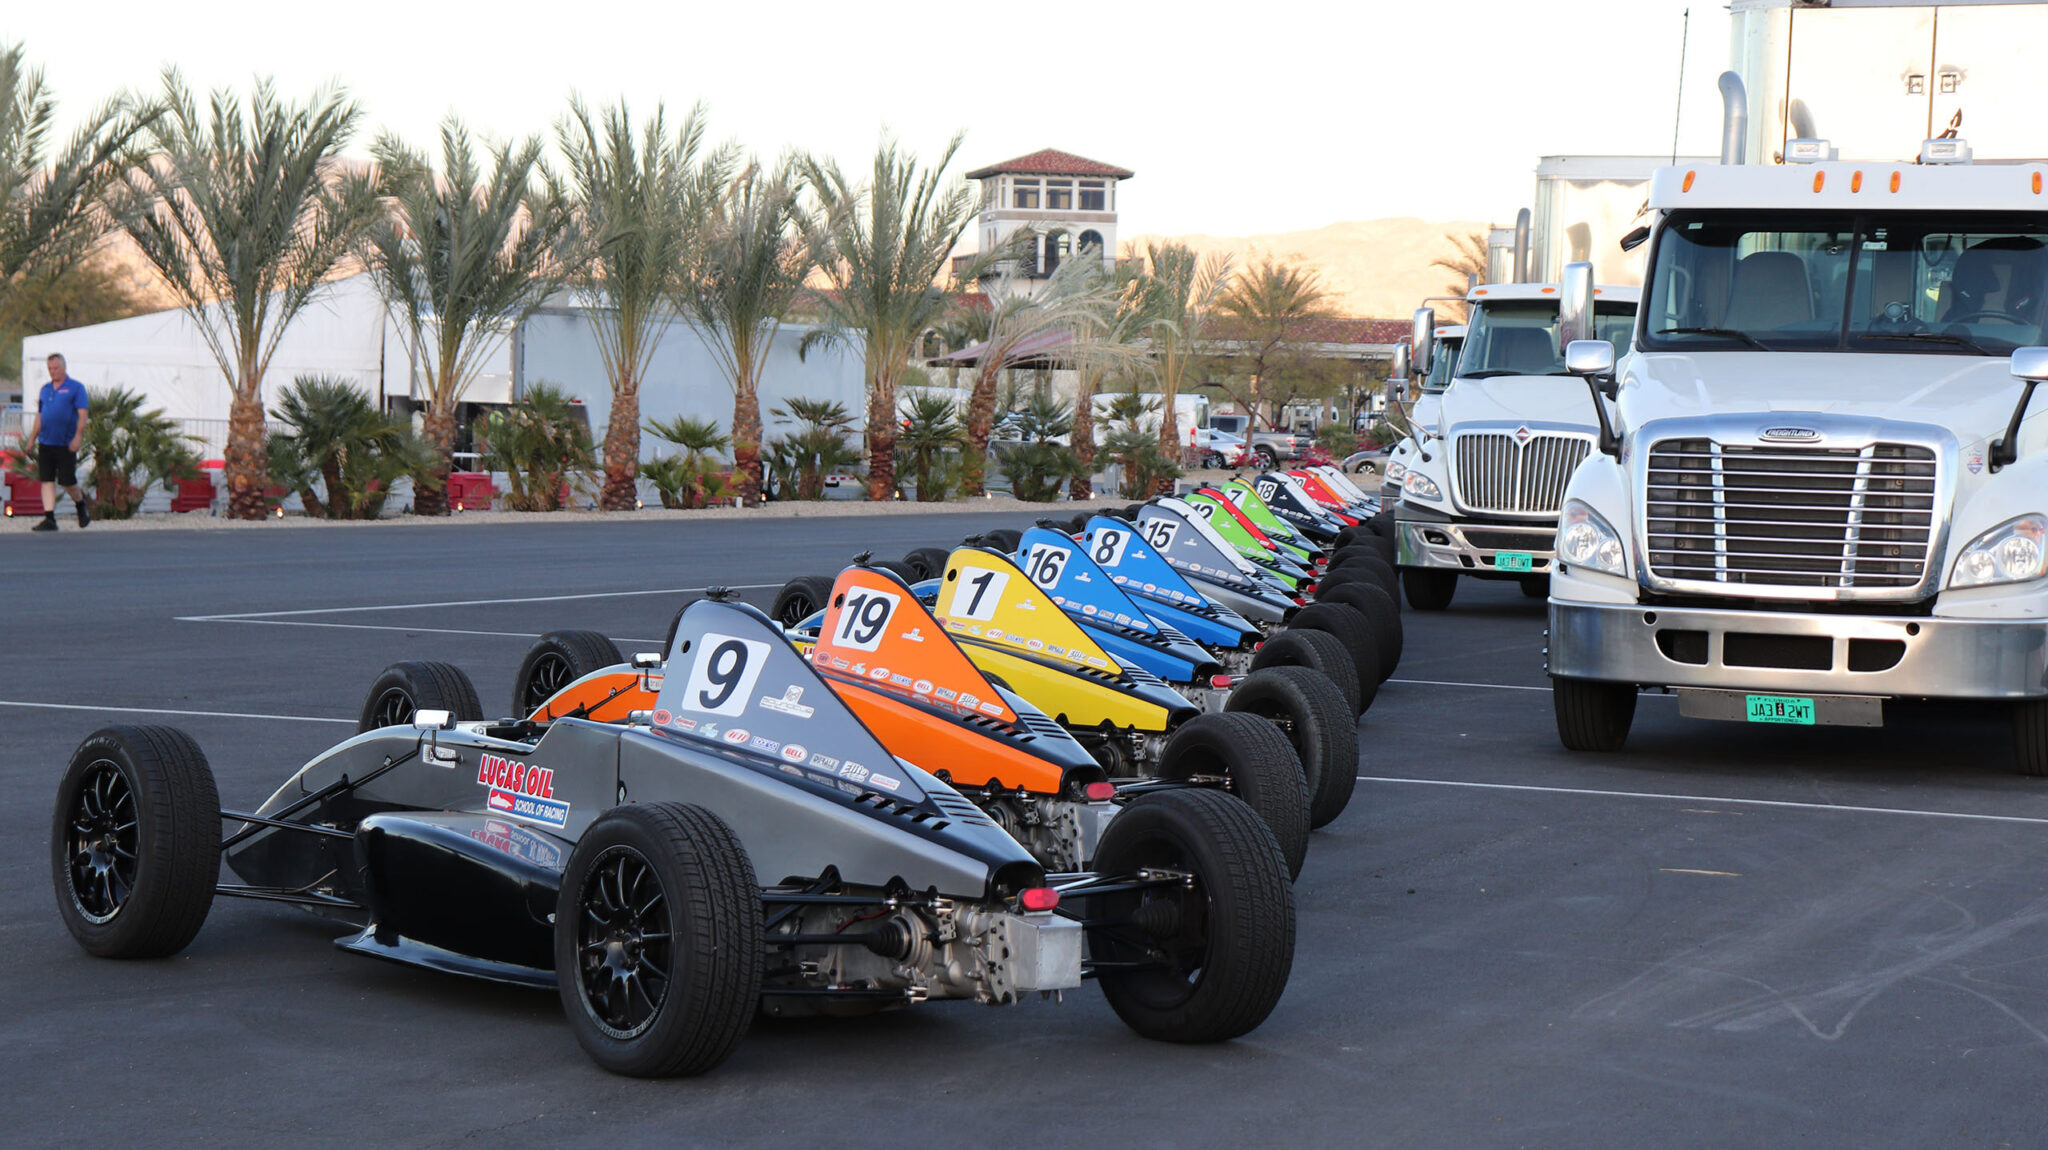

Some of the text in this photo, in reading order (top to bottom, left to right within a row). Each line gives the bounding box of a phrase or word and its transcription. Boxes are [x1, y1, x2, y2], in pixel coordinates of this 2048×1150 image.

[1766, 429, 1813, 437] FREIGHTLINER
[1230, 490, 1243, 503] 7
[1260, 484, 1274, 500] 18
[1095, 531, 1121, 564] 8
[1148, 521, 1176, 549] 15
[1029, 549, 1065, 585] 16
[966, 572, 995, 616] 1
[842, 593, 891, 644] 19
[699, 640, 748, 709] 9
[916, 682, 930, 691] BELL
[1751, 703, 1773, 717] JA3
[1788, 704, 1810, 718] 2WT
[785, 746, 803, 758] BELL
[478, 753, 525, 793] LUCAS
[526, 766, 553, 798] OIL
[514, 798, 565, 821] SCHOOL OF RACING
